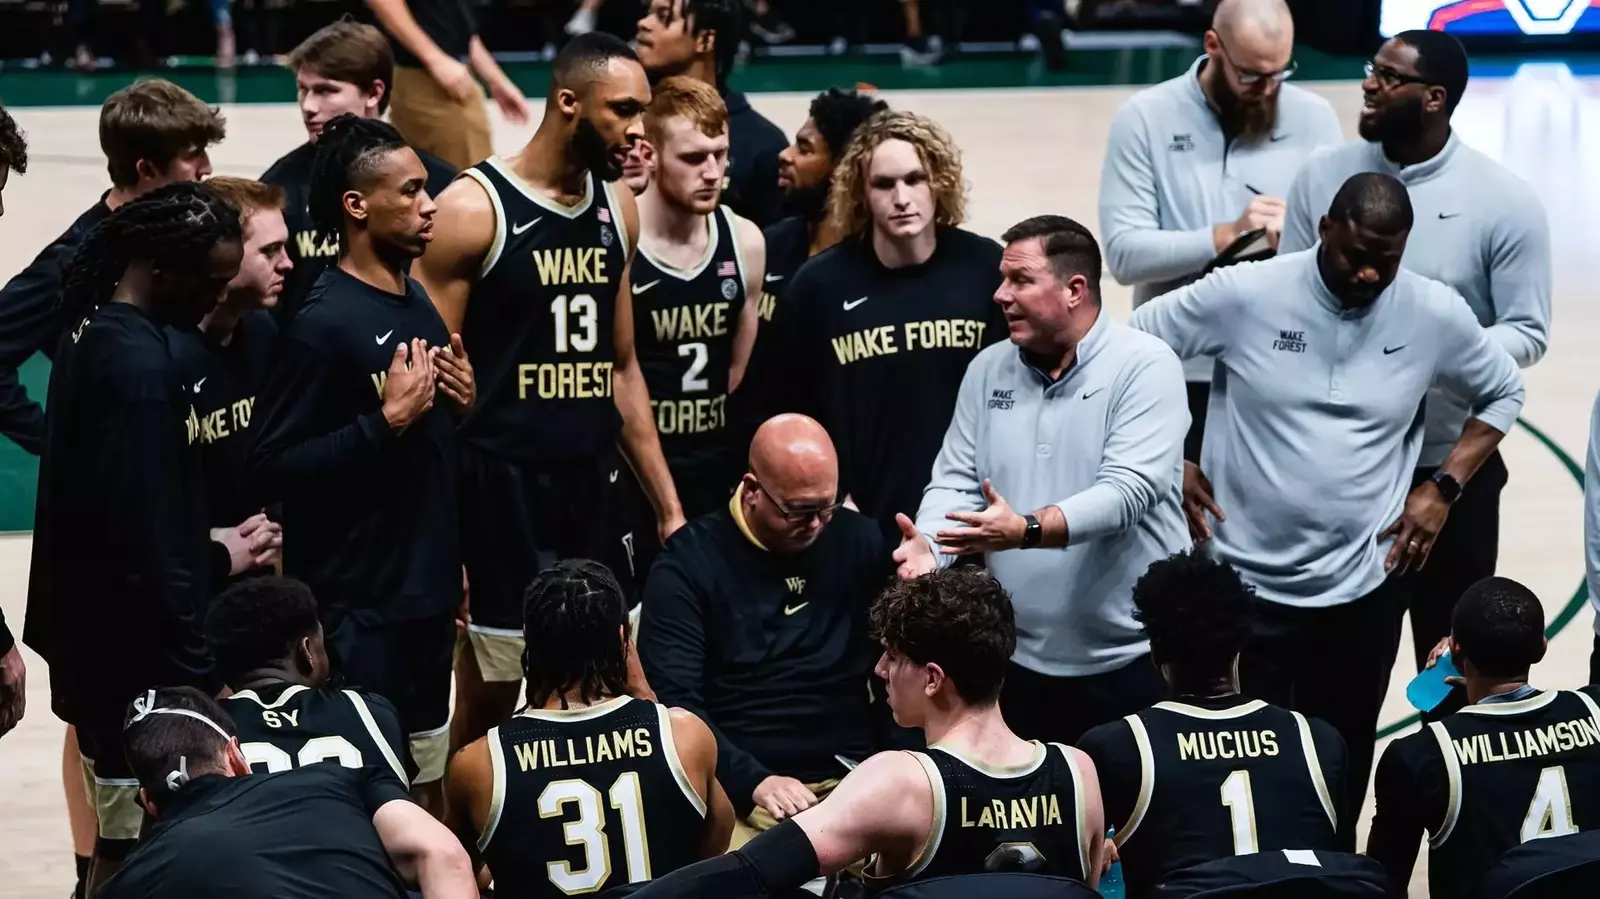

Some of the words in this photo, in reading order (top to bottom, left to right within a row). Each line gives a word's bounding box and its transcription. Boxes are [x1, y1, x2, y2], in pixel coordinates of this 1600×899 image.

[532, 247, 609, 286] WAKE
[551, 294, 598, 353] 13
[651, 302, 730, 341] WAKE
[1279, 329, 1305, 341] WAKE
[831, 325, 898, 365] WAKE
[905, 319, 987, 350] FOREST
[1272, 339, 1307, 353] FOREST
[518, 361, 613, 399] FOREST
[678, 342, 709, 393] 2
[987, 399, 1015, 410] FOREST
[992, 389, 1014, 399] WAKE
[262, 709, 299, 728] SY
[513, 728, 653, 772] WILLIAMS
[1176, 729, 1280, 760] MUCIUS
[1452, 716, 1600, 765] WILLIAMSON
[1220, 769, 1259, 856] 1
[1519, 765, 1579, 844] 4
[536, 771, 652, 896] 31
